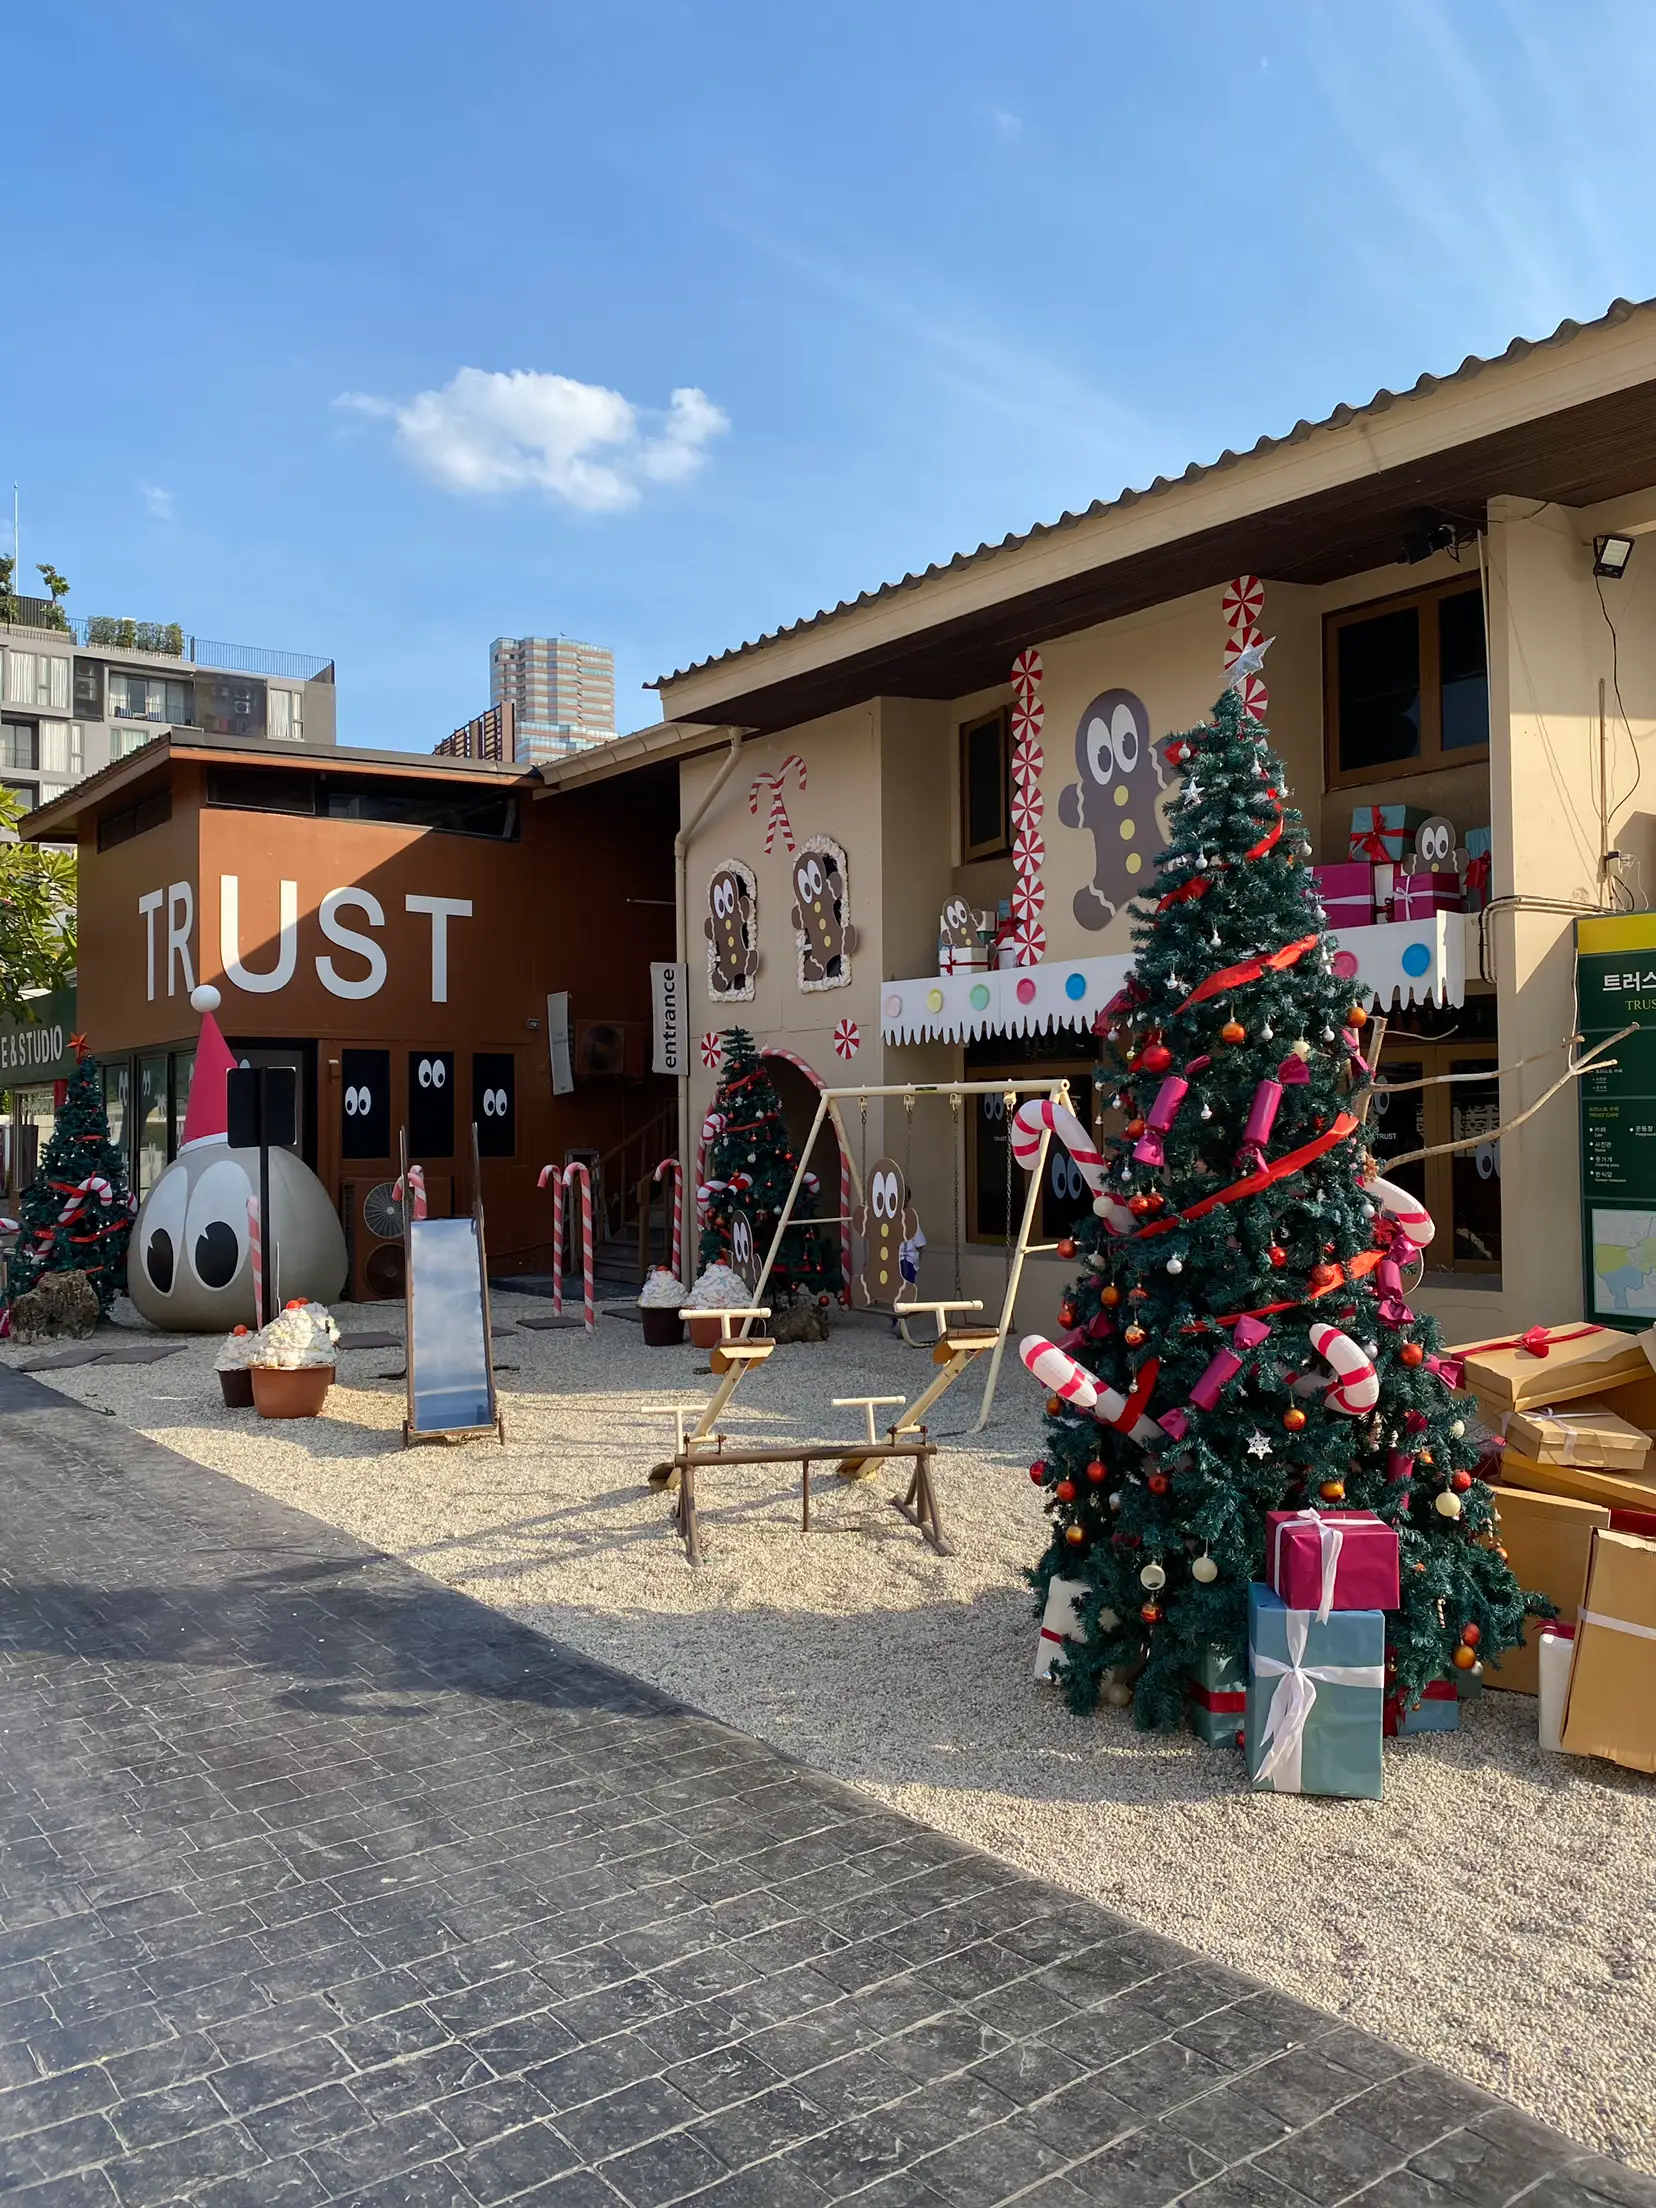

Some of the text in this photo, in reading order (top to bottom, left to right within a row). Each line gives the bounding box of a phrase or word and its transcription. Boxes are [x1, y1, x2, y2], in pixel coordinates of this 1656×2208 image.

[139, 874, 473, 1003] TRUST
[1603, 972, 1656, 991] 트러스
[663, 968, 677, 1068] entrance
[19, 1024, 63, 1066] STUDIO
[1376, 1132, 1397, 1140] TRUST
